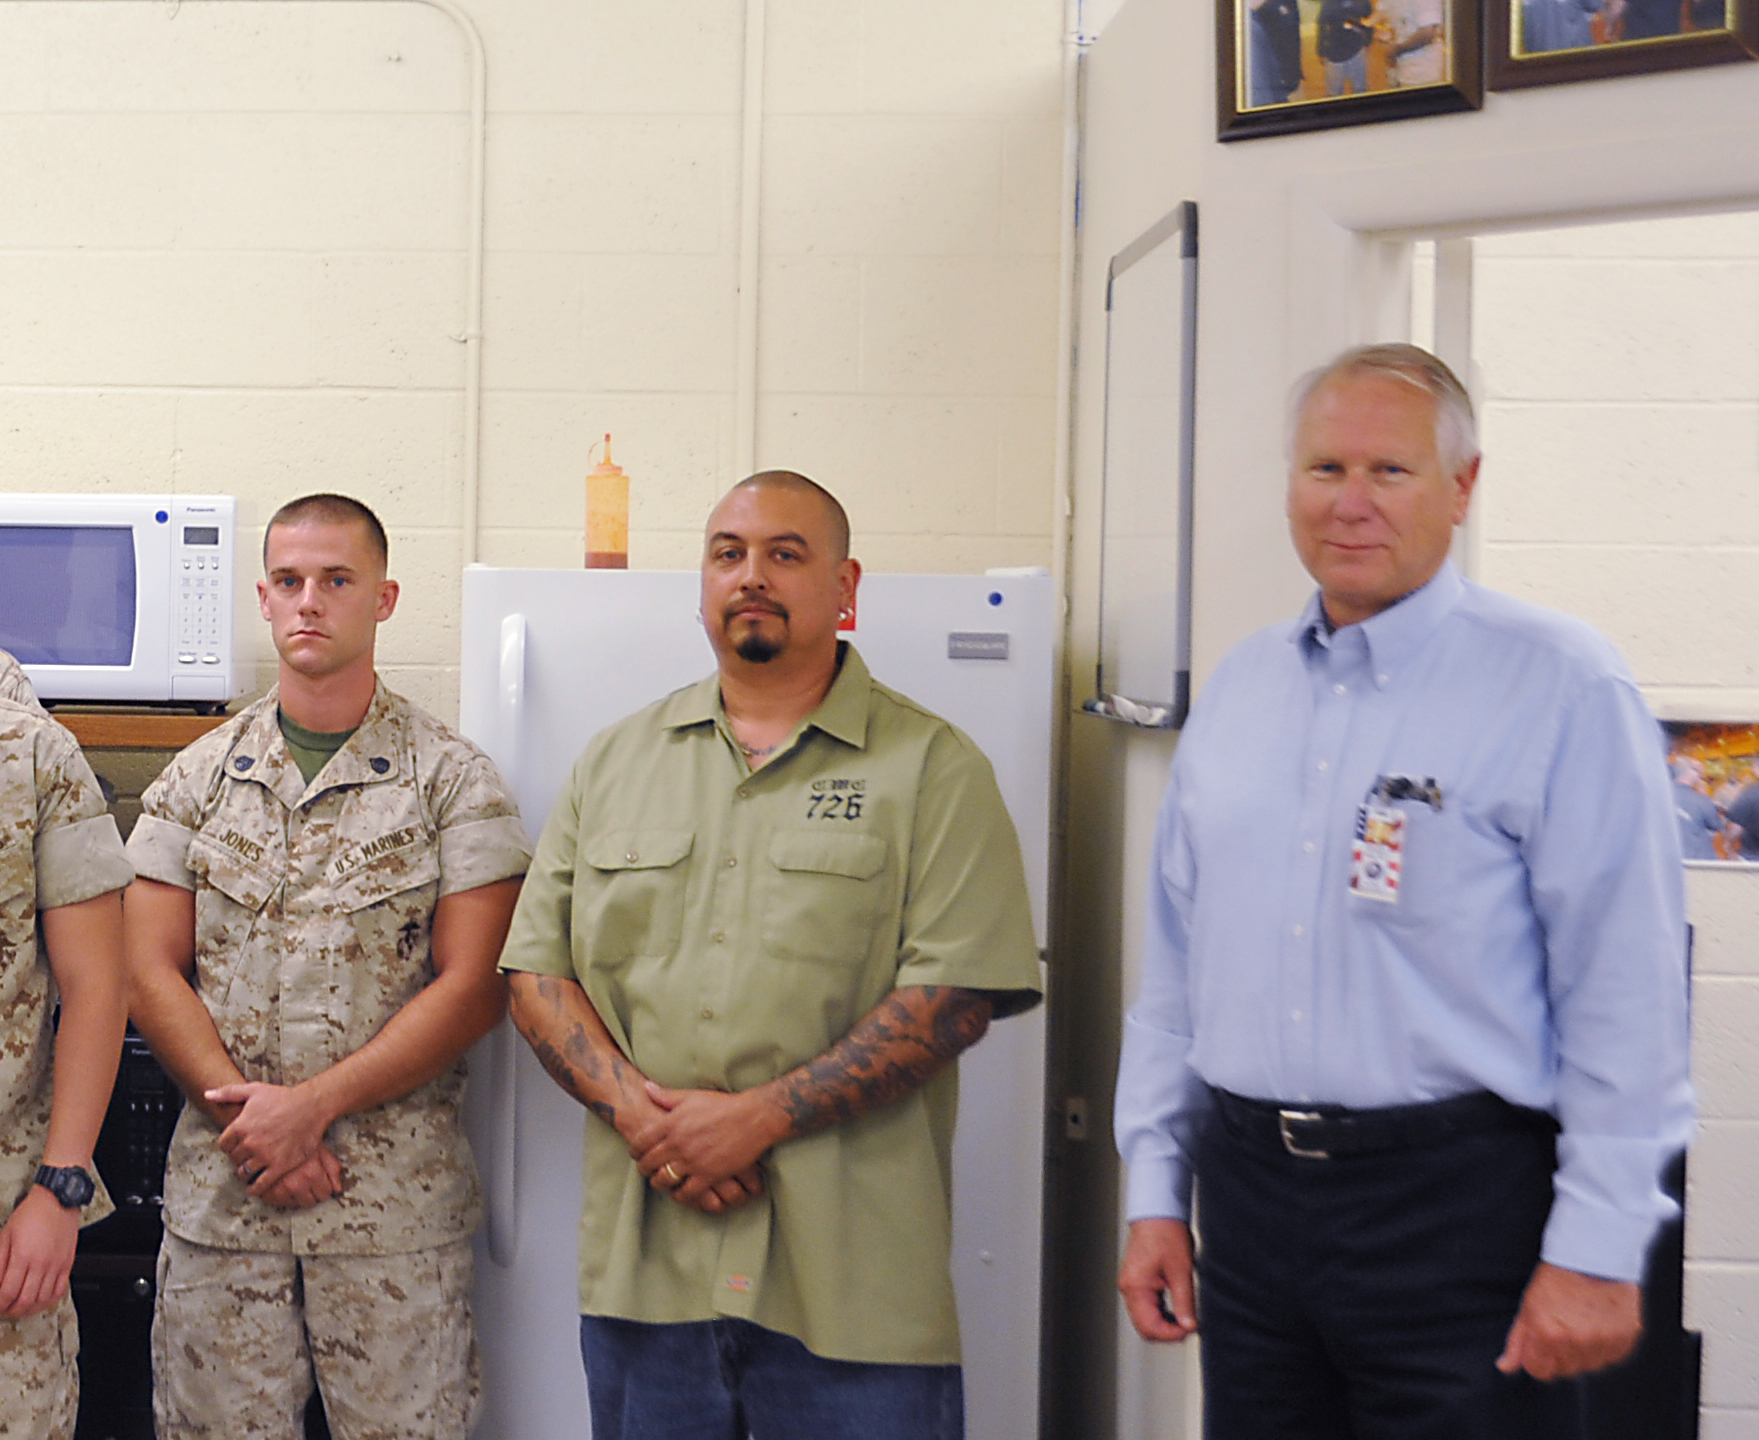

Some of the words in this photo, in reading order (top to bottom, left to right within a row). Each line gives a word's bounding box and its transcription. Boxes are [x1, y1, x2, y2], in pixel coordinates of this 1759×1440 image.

[807, 793, 864, 820] 726
[219, 828, 265, 863] JONES
[360, 826, 415, 861] MARINES
